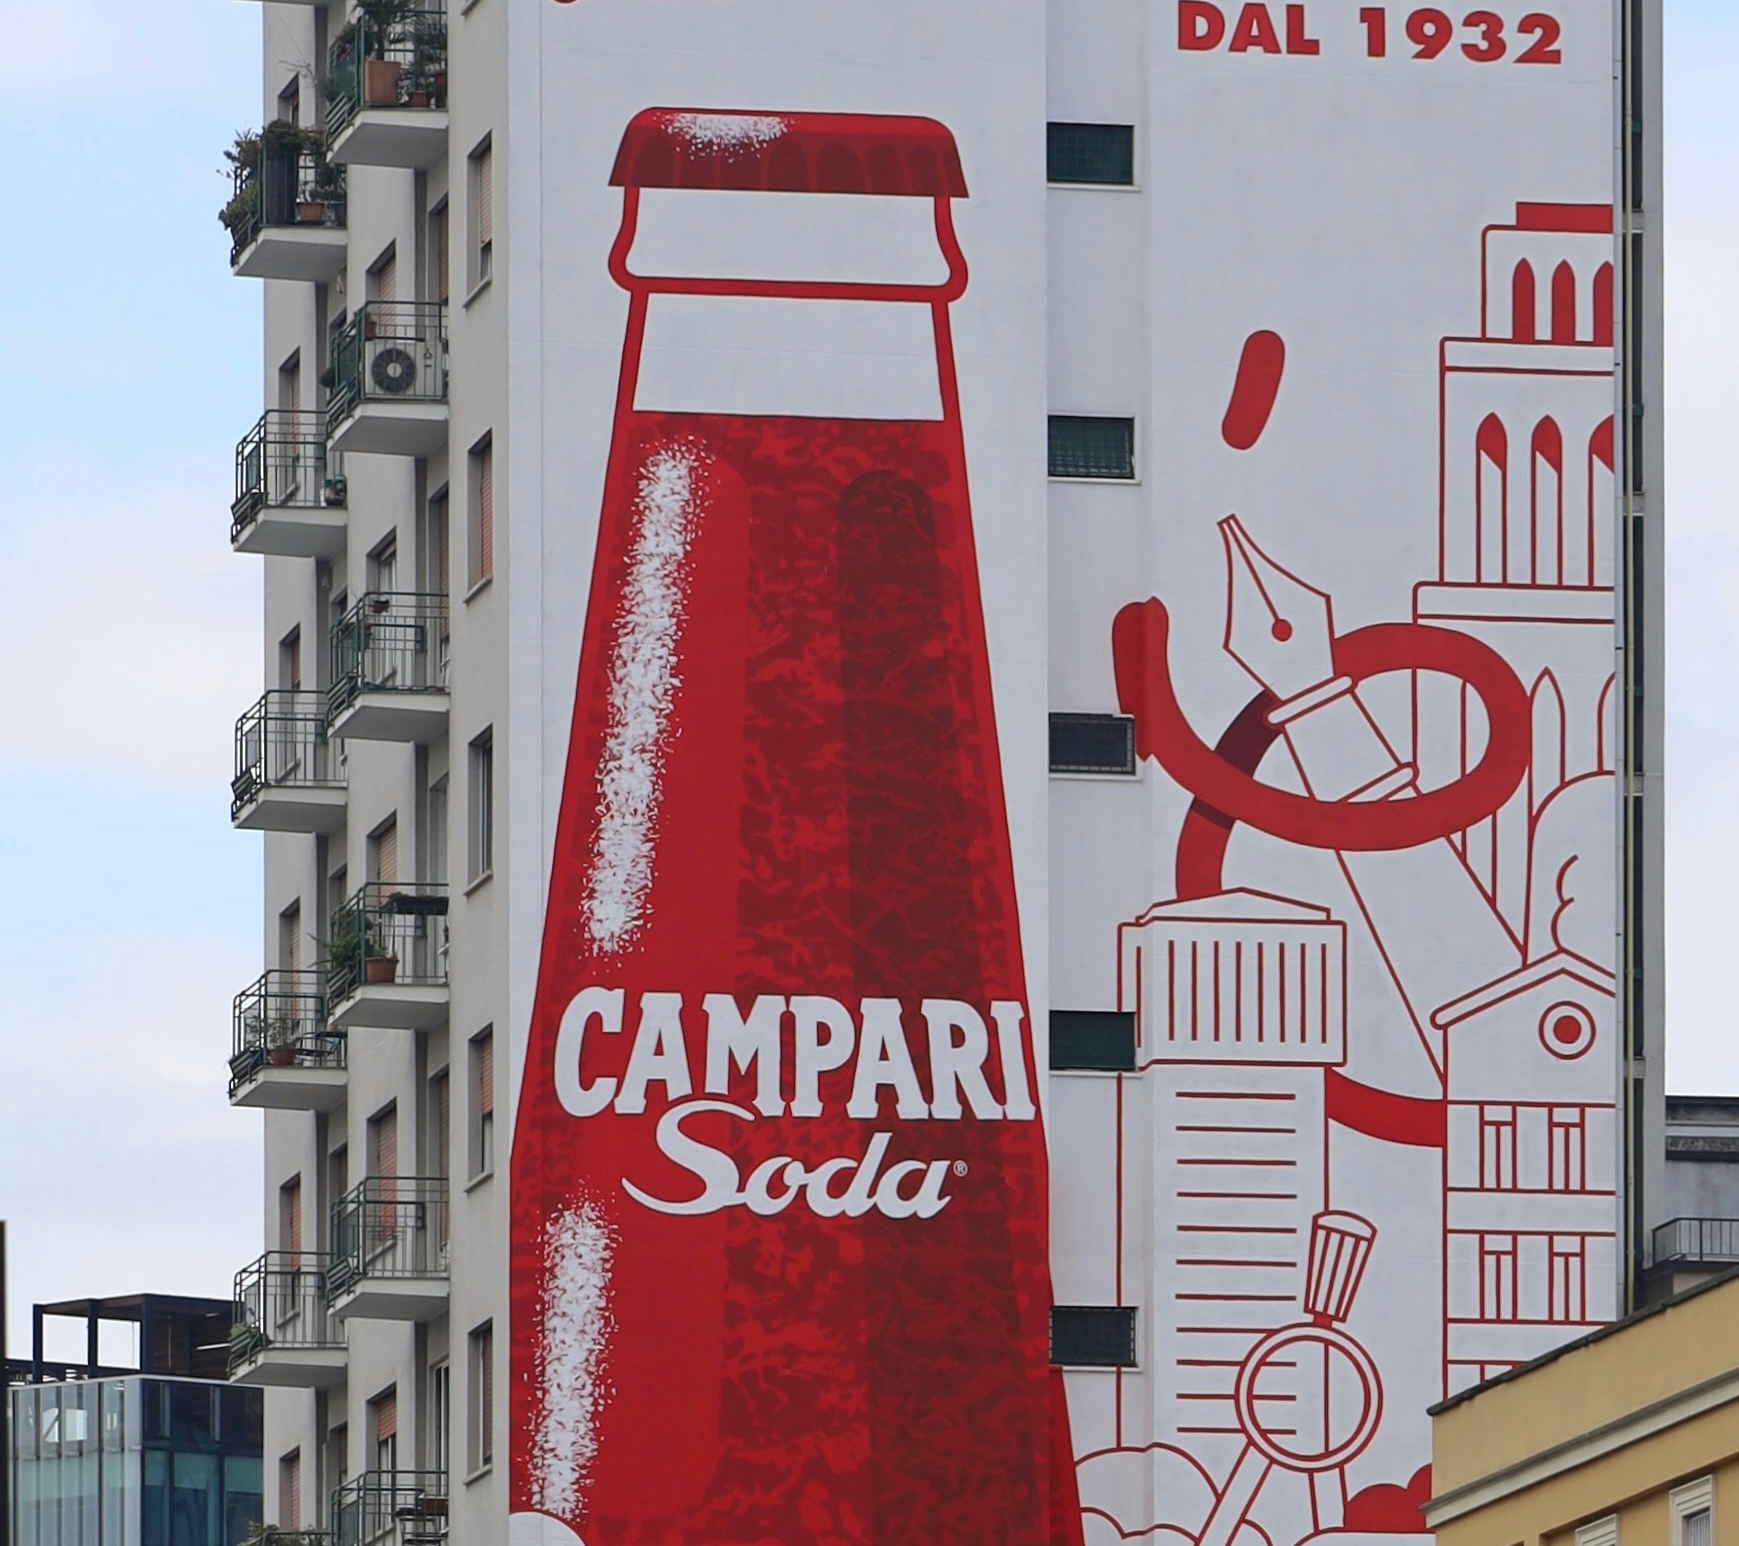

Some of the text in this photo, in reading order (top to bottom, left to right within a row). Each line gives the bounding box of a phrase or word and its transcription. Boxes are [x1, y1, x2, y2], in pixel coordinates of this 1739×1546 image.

[1178, 0, 1563, 64] DAL 1932
[554, 986, 1037, 1121] CAMPARI
